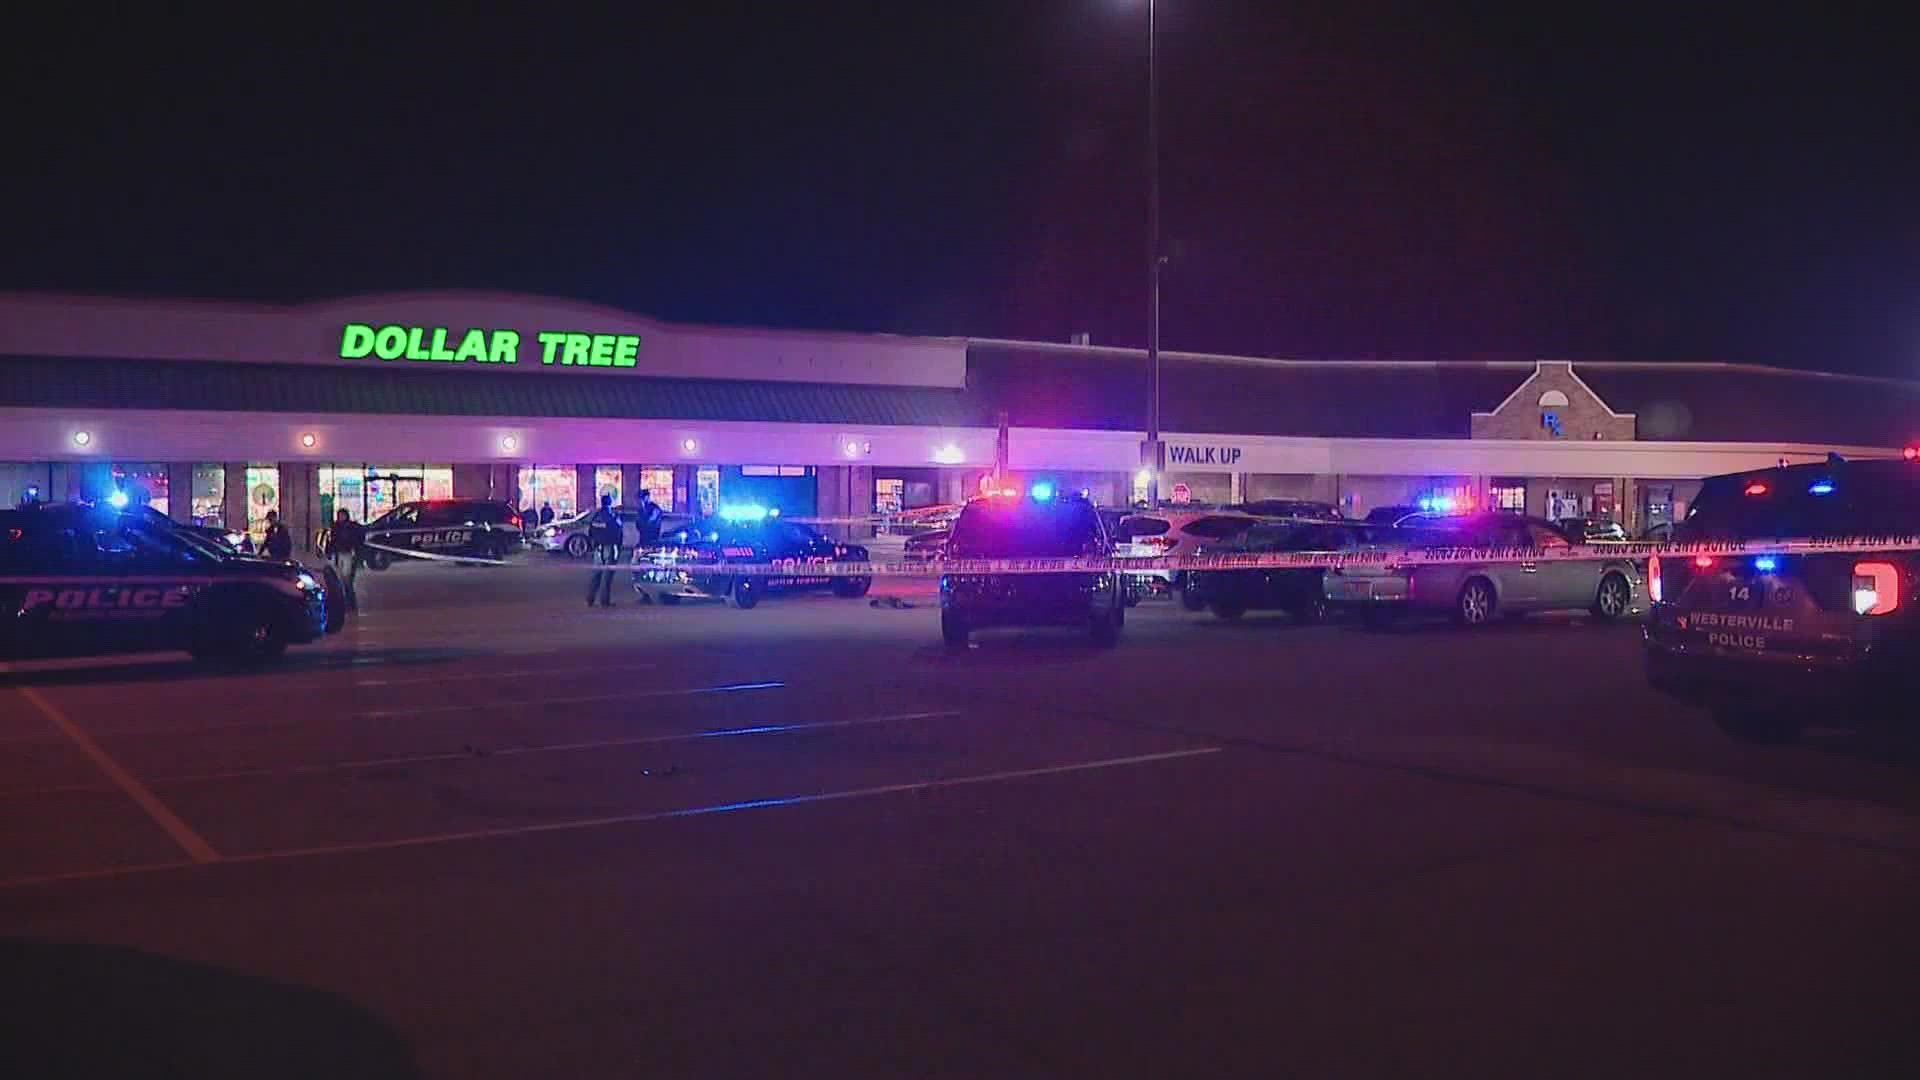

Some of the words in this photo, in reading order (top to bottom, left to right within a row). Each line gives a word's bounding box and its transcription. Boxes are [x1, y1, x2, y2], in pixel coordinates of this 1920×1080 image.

[340, 324, 520, 363] DOLLAR
[538, 332, 641, 368] TREE
[1170, 446, 1215, 464] WALK
[1220, 447, 1241, 464] UP
[411, 528, 473, 546] POLICE
[22, 589, 189, 609] POLICE
[1729, 586, 1750, 601] 14
[1689, 611, 1794, 632] WESTERVILLE
[1708, 632, 1766, 650] POLICE
